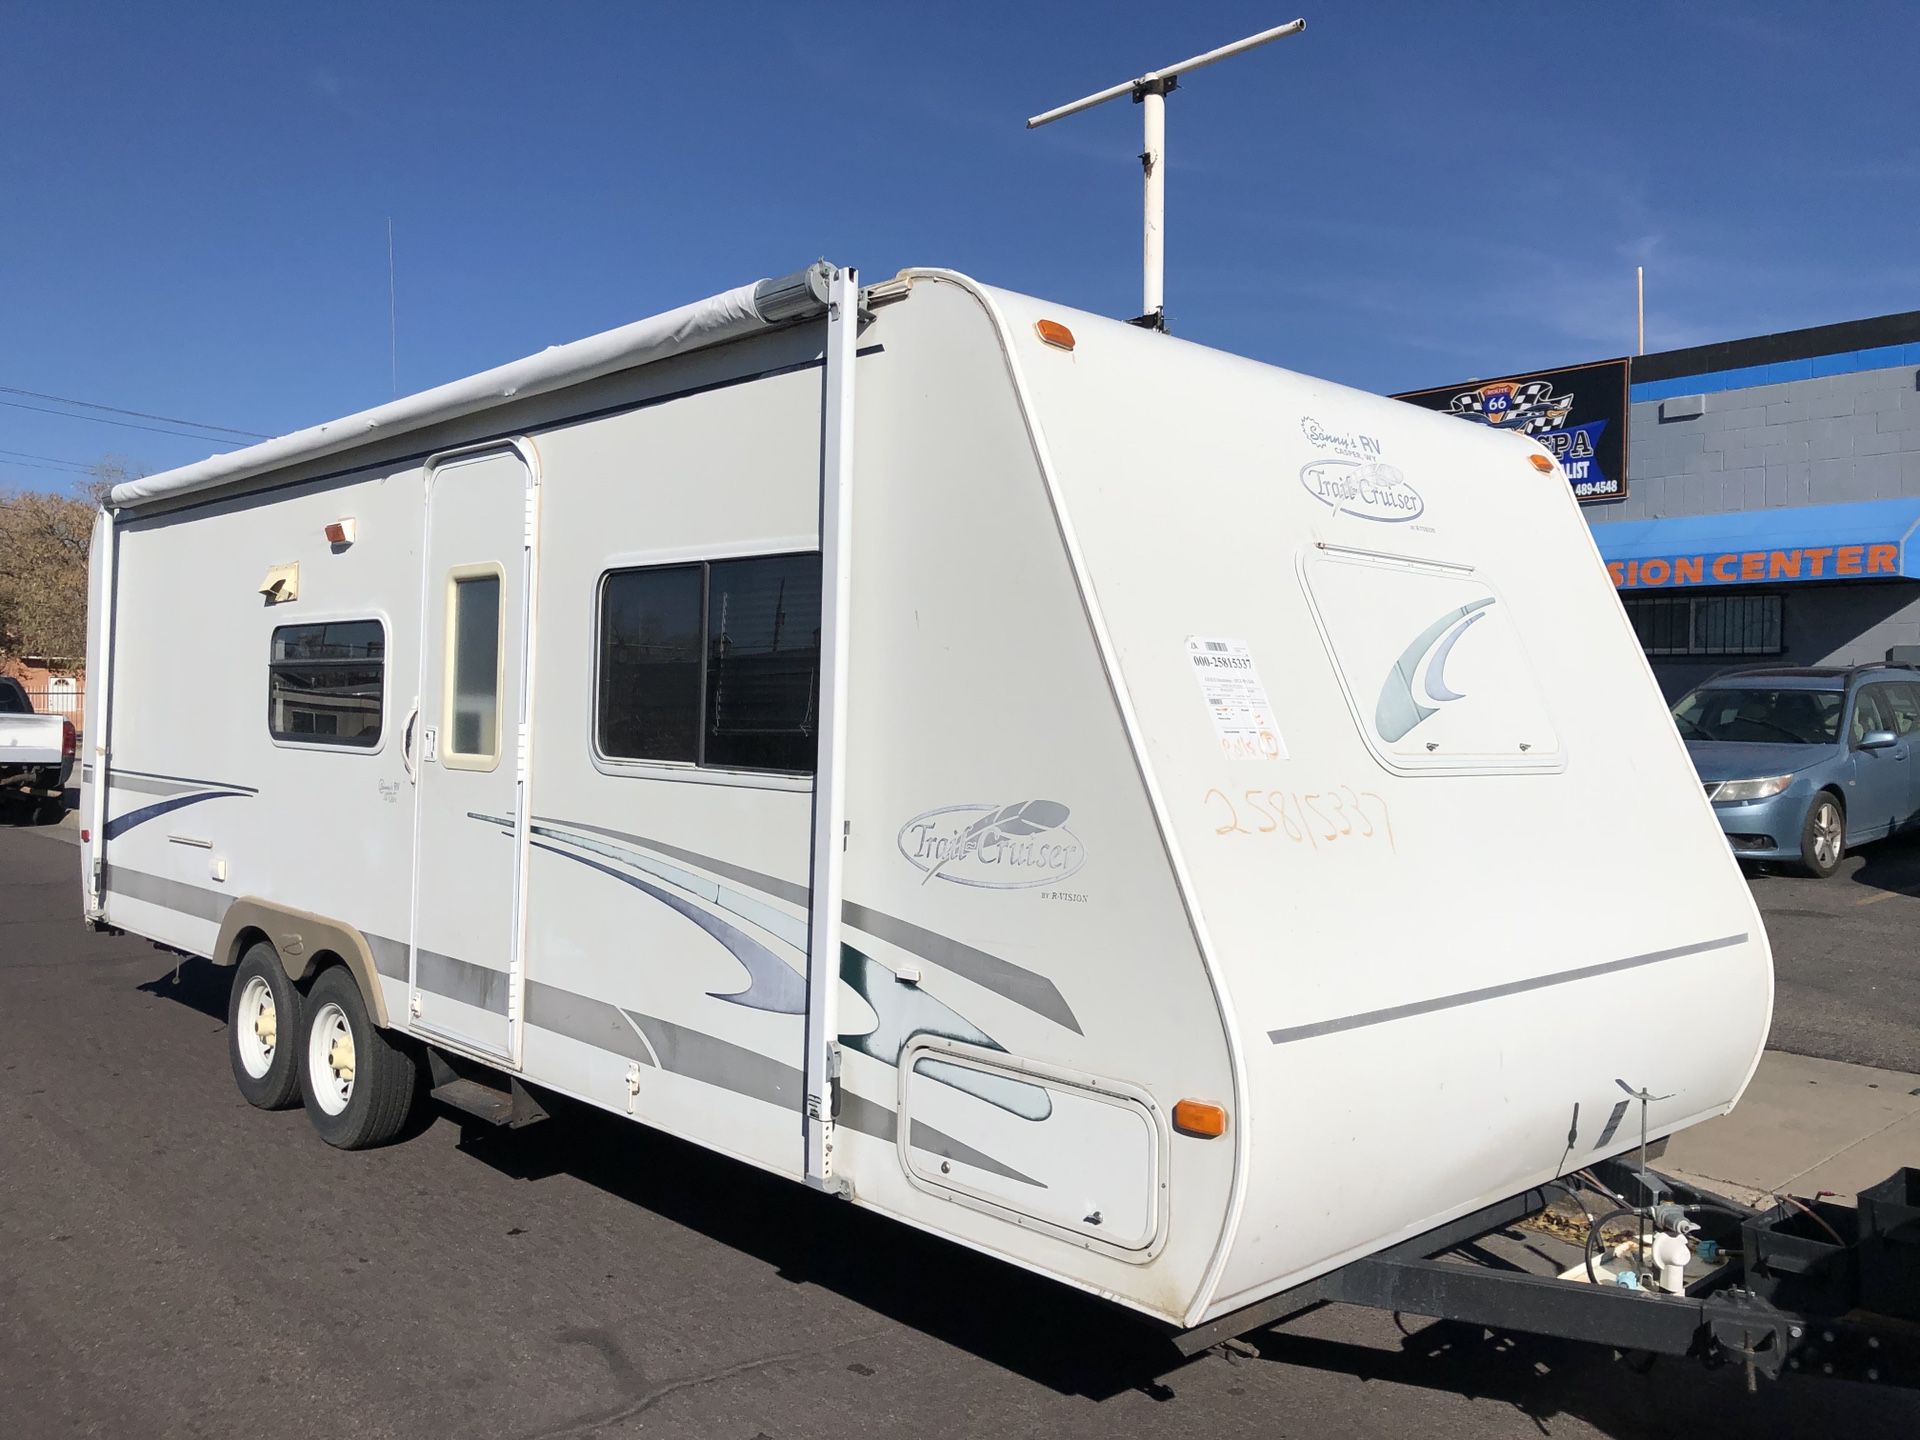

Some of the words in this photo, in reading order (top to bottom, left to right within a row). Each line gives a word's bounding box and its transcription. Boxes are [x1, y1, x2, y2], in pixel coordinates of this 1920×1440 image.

[1489, 397, 1507, 411] 66
[1358, 435, 1381, 455] RV
[1359, 479, 1417, 511] Cruiser
[1575, 480, 1618, 495] 489-4548
[1712, 545, 1899, 580] CENTER
[1193, 655, 1252, 669] 000-25815337
[1204, 784, 1396, 855] 25815337
[911, 822, 974, 861] Trail
[977, 829, 1077, 870] Cruiser
